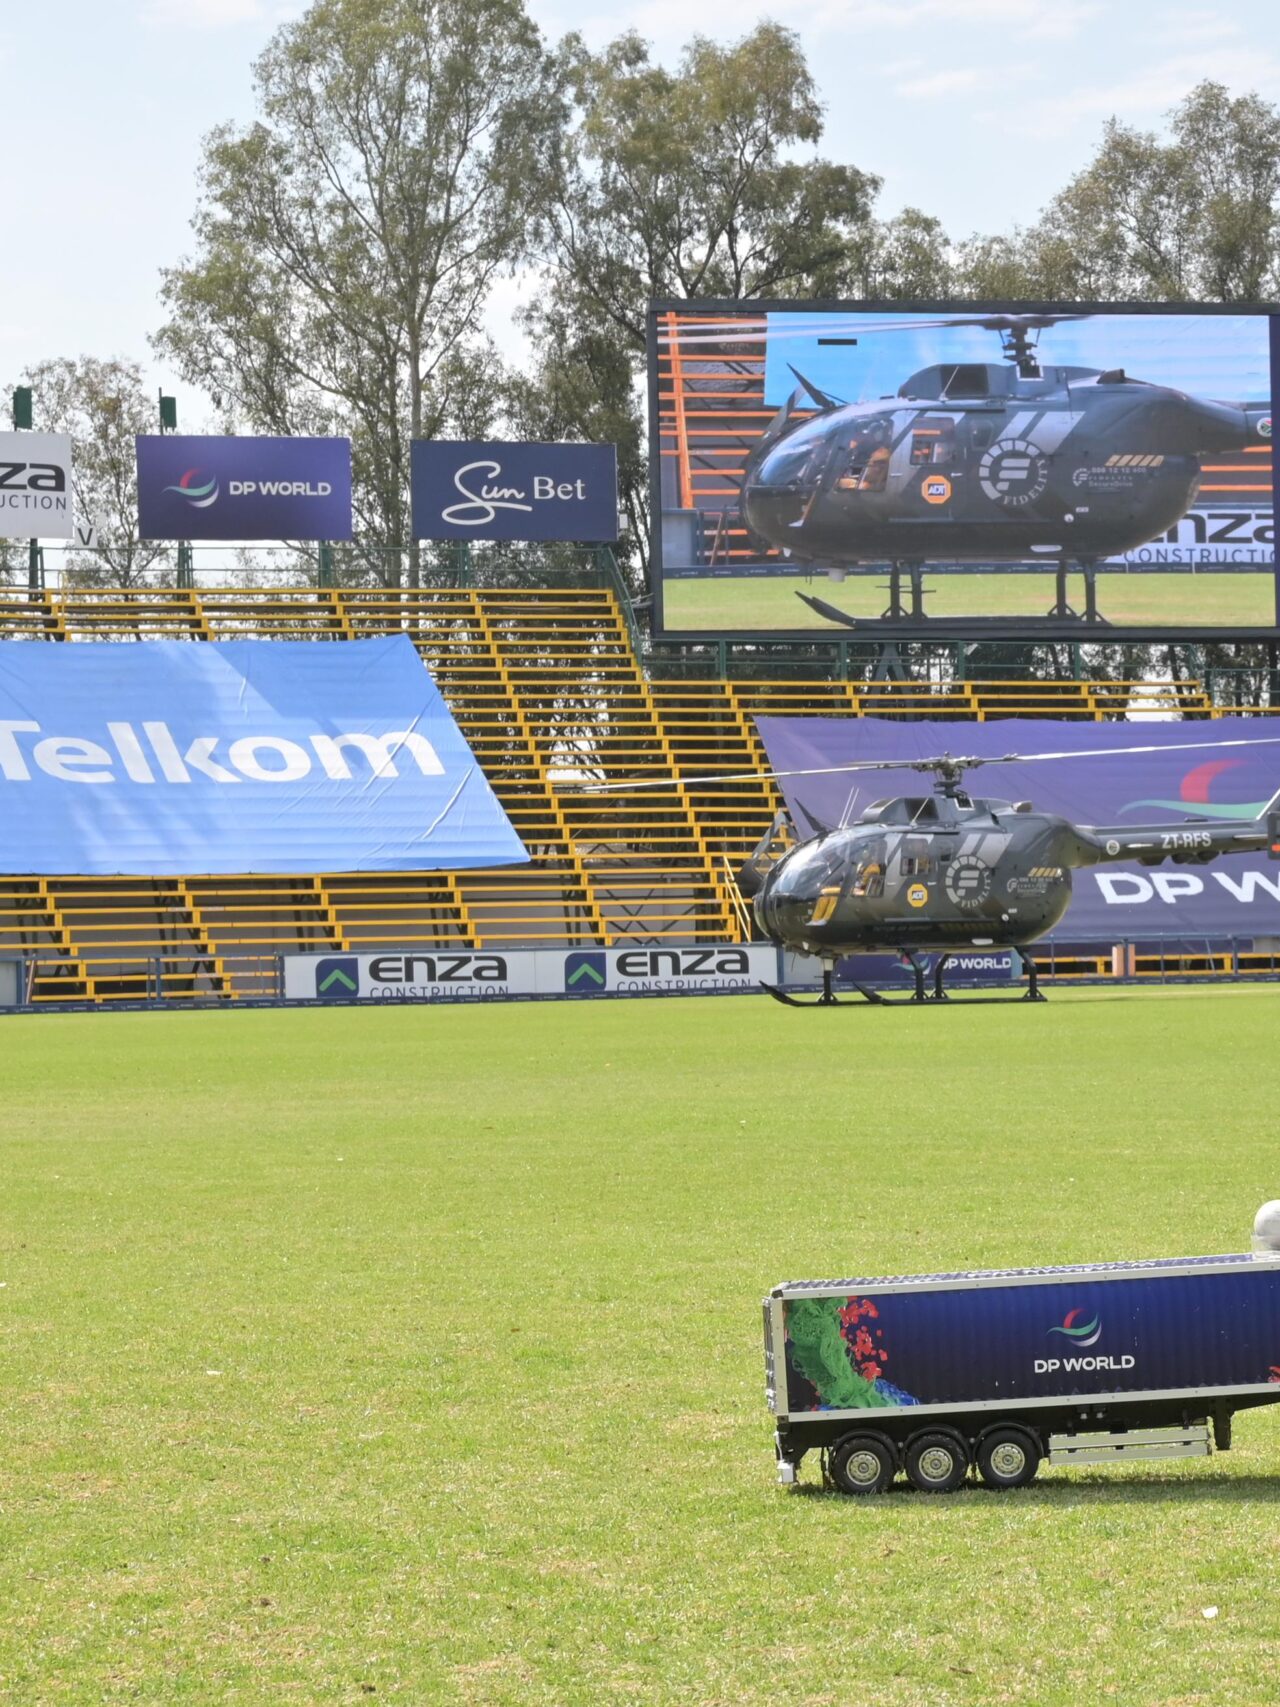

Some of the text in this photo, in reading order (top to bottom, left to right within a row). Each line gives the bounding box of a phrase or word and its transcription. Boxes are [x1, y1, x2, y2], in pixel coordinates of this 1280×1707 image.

[229, 481, 332, 497] DP WORLD
[442, 461, 586, 525] Sun Bet
[0, 720, 446, 783] Telkom
[1160, 832, 1212, 849] ZT-RFS
[1095, 872, 1204, 904] DP
[369, 956, 508, 982] enza
[616, 949, 750, 977] enza
[960, 957, 1012, 970] WORLD
[370, 985, 509, 998] CONSTRUCTION
[617, 978, 751, 991] CONSTRUCTION
[1034, 1355, 1135, 1373] DP WORLD
